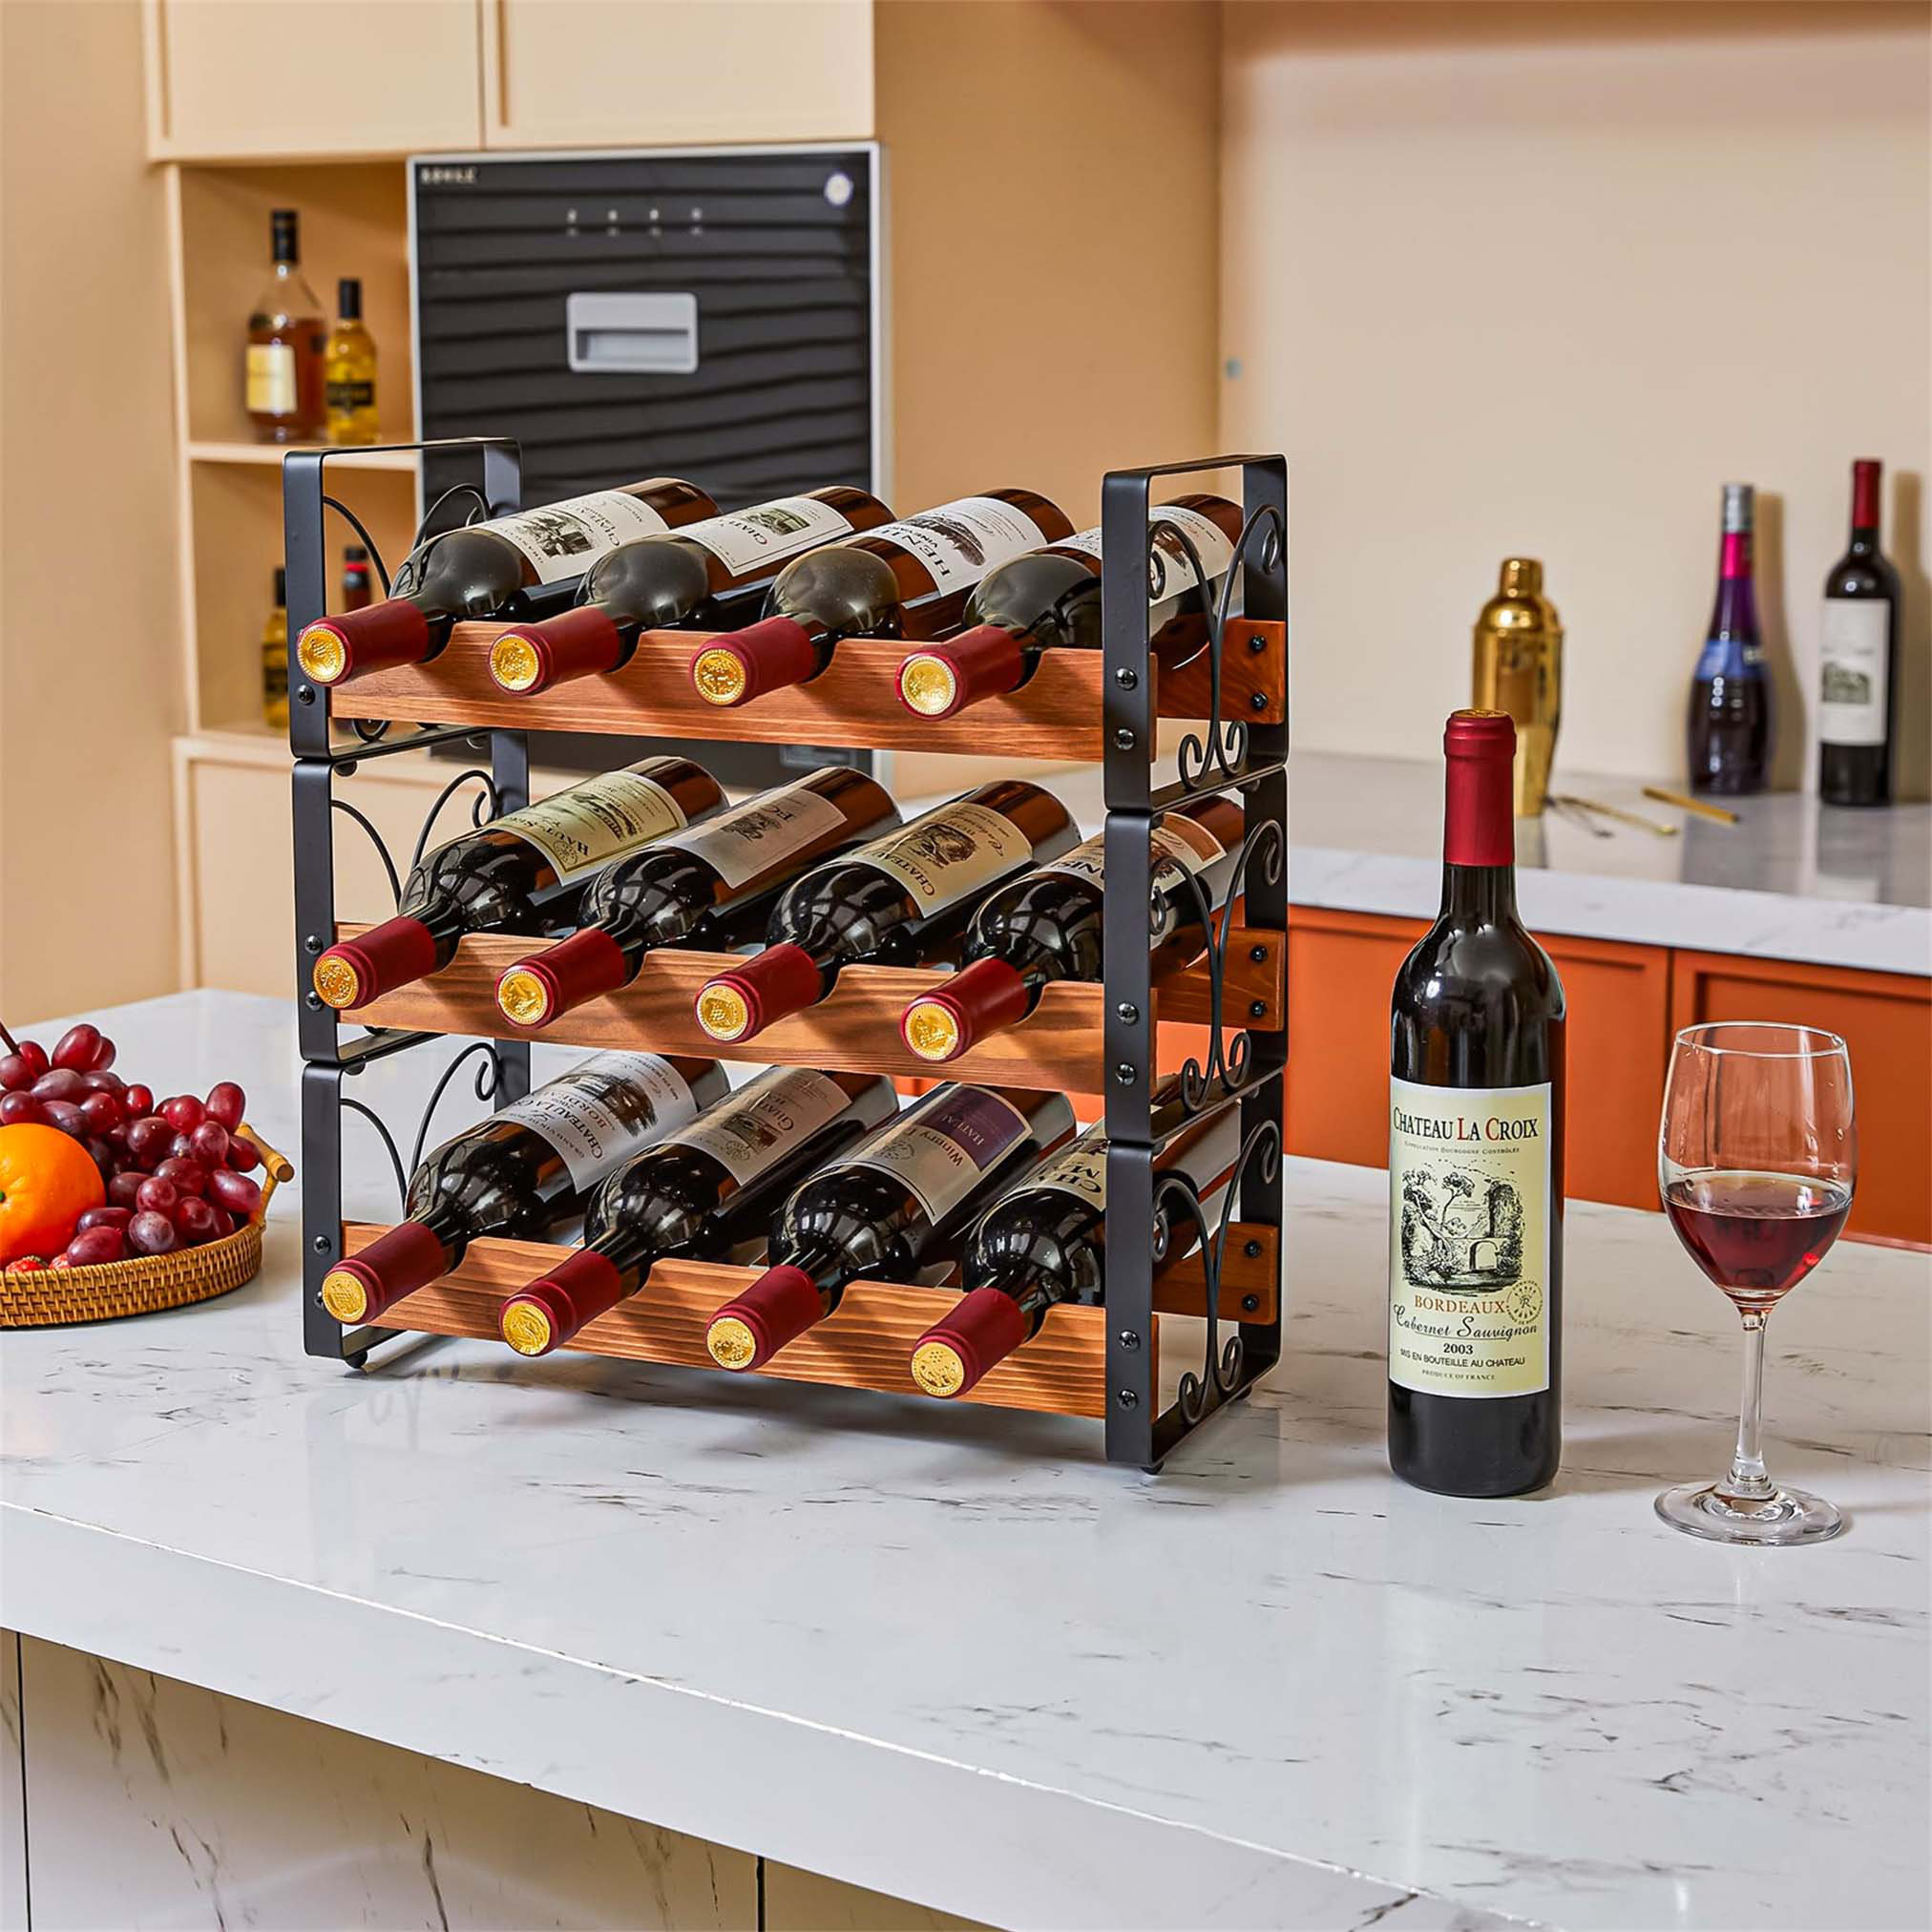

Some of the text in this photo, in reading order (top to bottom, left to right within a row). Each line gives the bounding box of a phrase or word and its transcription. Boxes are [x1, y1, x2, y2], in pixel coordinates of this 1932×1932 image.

[871, 851, 935, 896] CHATEAU
[552, 1105, 603, 1159] CHATEAU
[1394, 1106, 1539, 1141] CHATEAU LA CROIX
[918, 1131, 961, 1166] Winery
[1415, 1294, 1505, 1314] BORDEAUX
[1394, 1304, 1537, 1341] Cabernet Sauvignon
[1399, 1348, 1526, 1368] MIS EN BOUTEILLE AU CHATEAU
[1442, 1342, 1474, 1355] 2003
